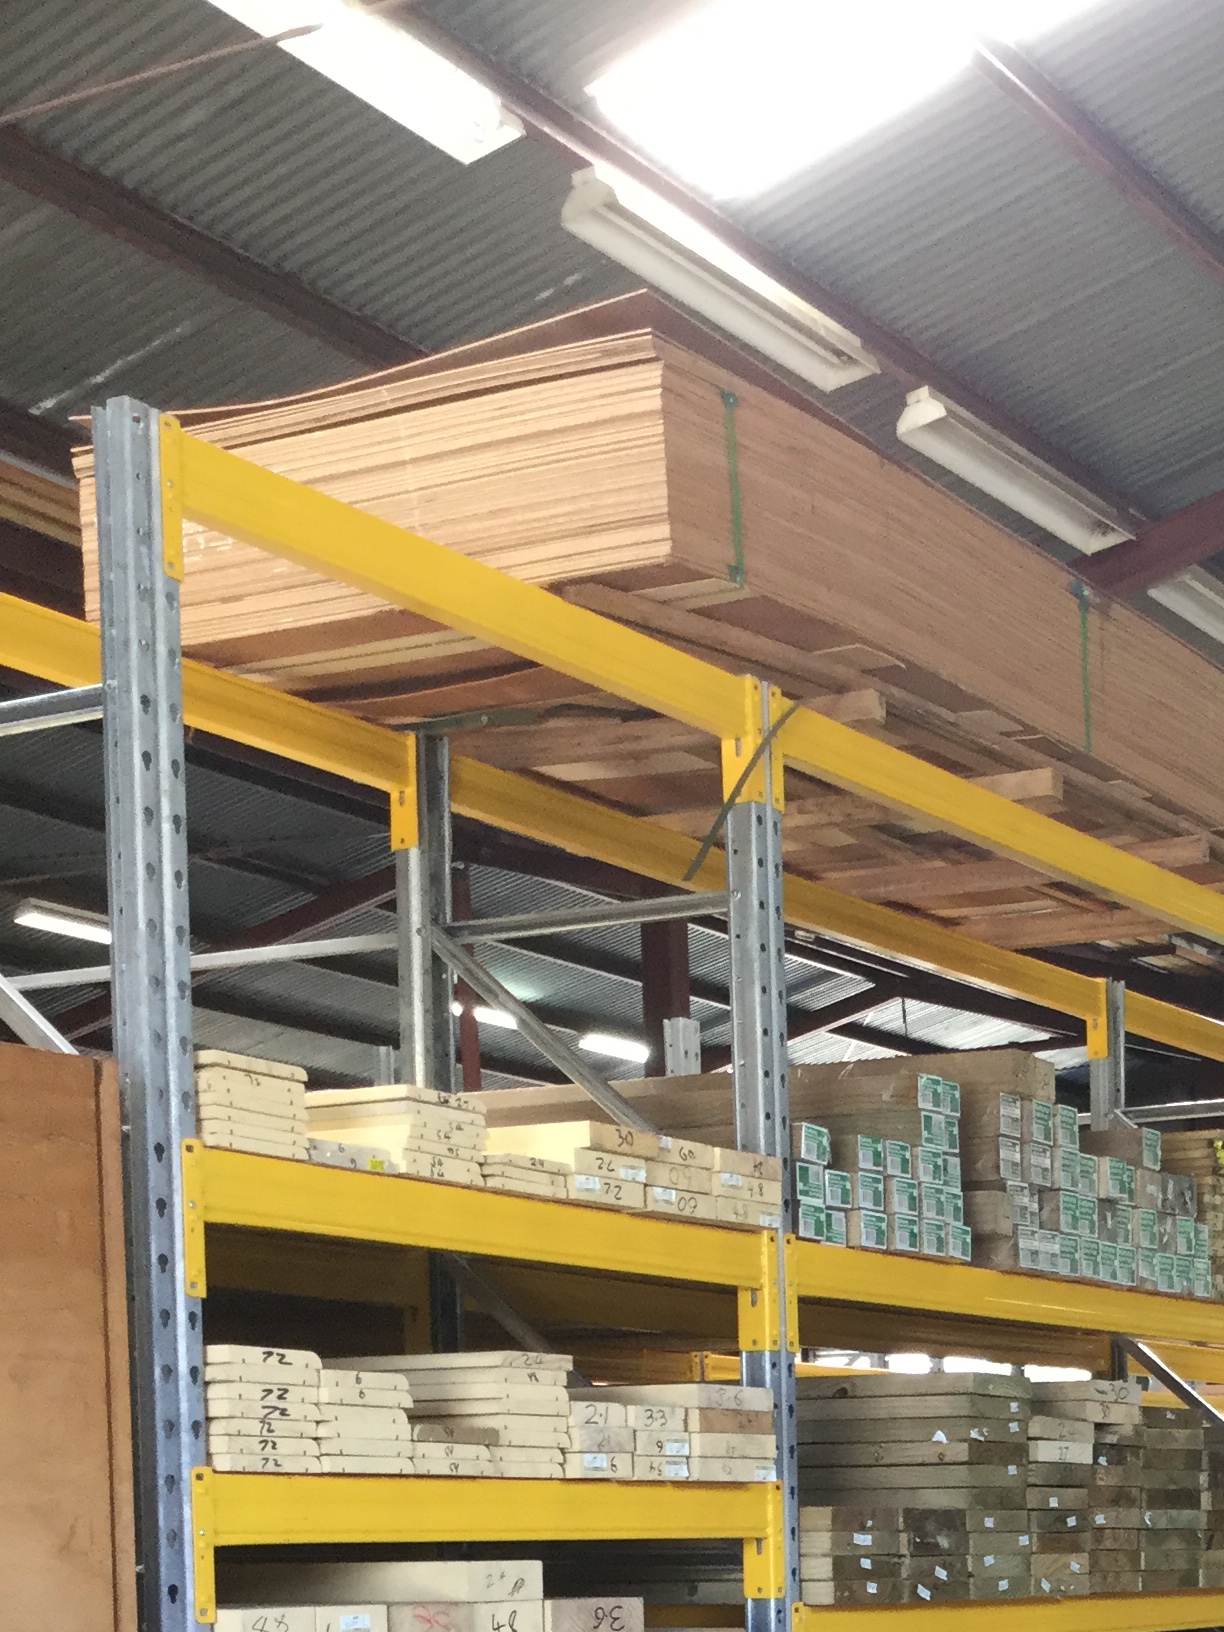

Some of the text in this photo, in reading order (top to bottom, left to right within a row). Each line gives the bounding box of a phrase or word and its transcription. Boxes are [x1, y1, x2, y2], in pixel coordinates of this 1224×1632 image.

[615, 1128, 634, 1148] 30
[262, 1351, 293, 1365] 72
[260, 1388, 290, 1401] 72
[261, 1405, 292, 1420] 72
[258, 1439, 278, 1452] 72
[261, 1457, 283, 1469] 72
